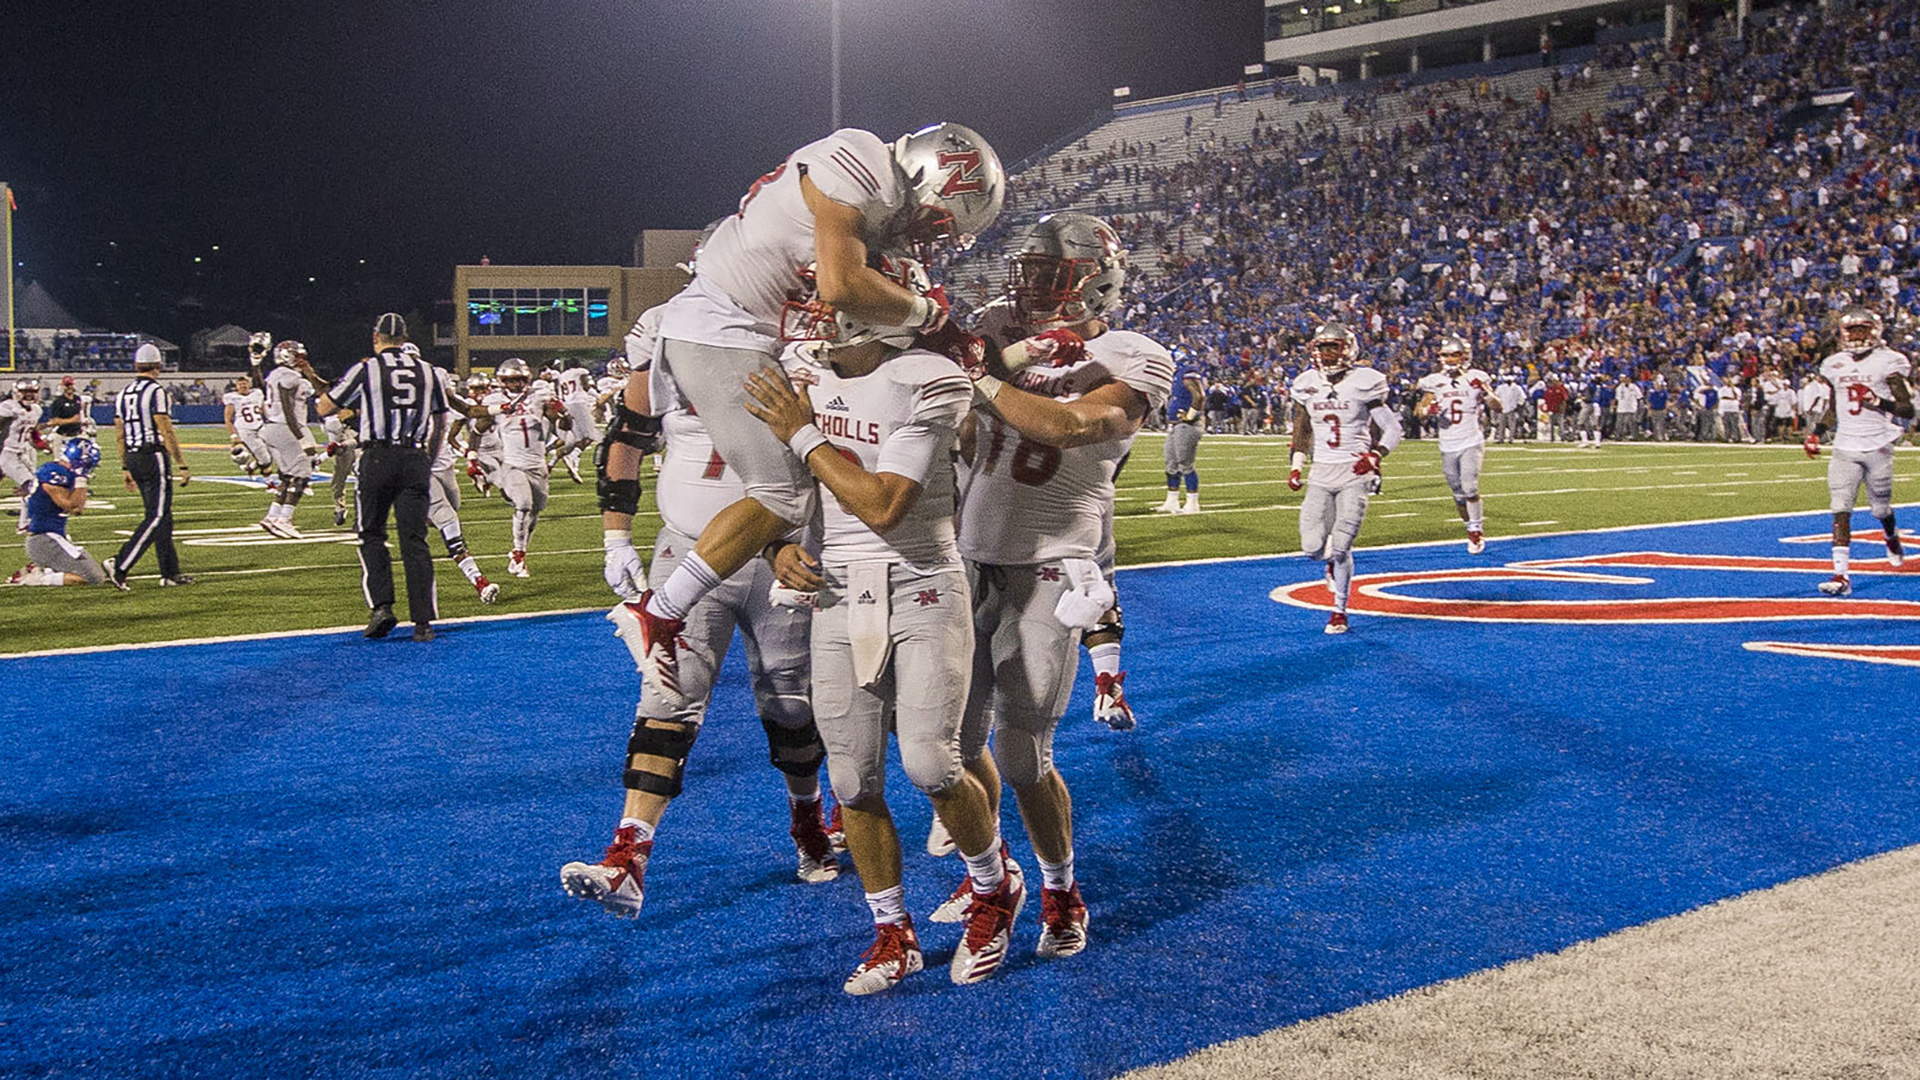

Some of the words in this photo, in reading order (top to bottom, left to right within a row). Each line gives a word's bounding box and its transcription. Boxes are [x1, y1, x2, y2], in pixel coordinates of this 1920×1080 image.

[390, 369, 417, 405] S
[1450, 398, 1463, 425] 6
[519, 418, 530, 448] 1
[1322, 413, 1341, 450] 3
